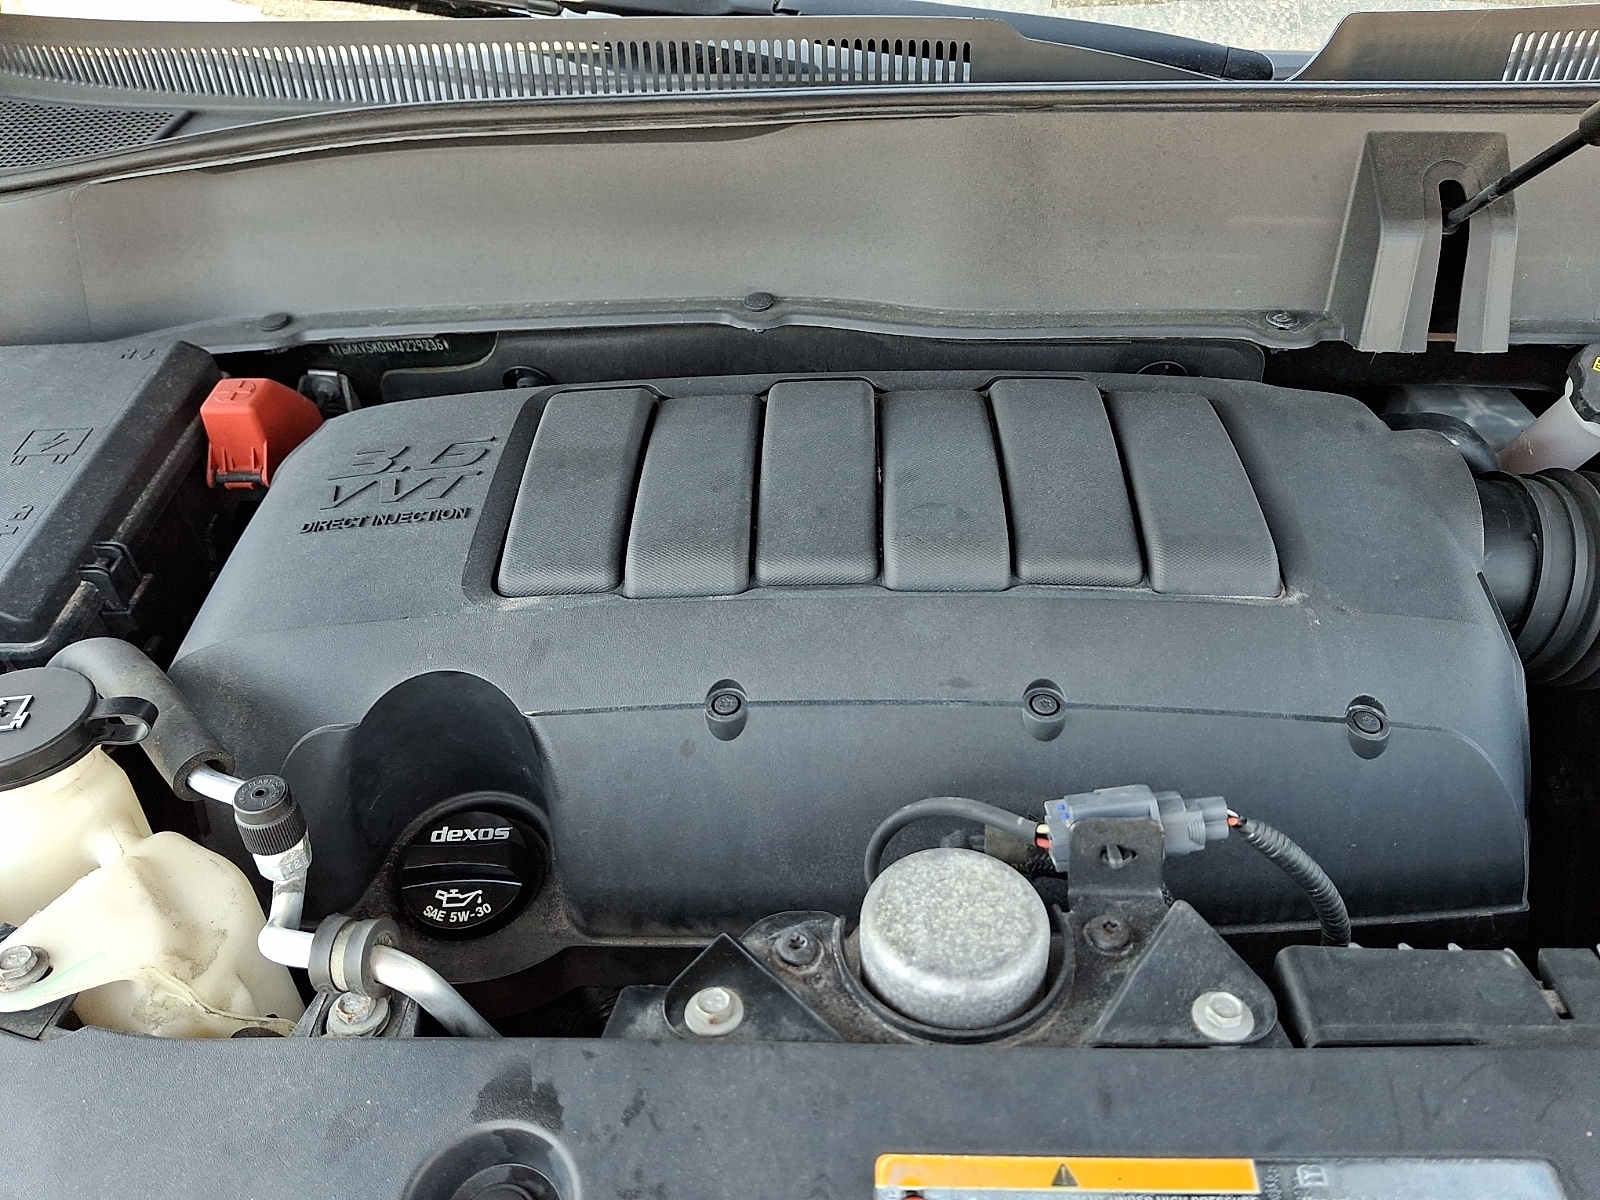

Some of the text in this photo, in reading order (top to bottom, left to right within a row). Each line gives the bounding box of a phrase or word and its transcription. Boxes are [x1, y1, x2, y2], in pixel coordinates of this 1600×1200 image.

[327, 435, 497, 481] 3.6
[319, 470, 483, 511] VVT
[299, 506, 472, 534] DIRECT INJECTION
[430, 826, 511, 843] dexos
[422, 903, 492, 922] SAE 5W-30
